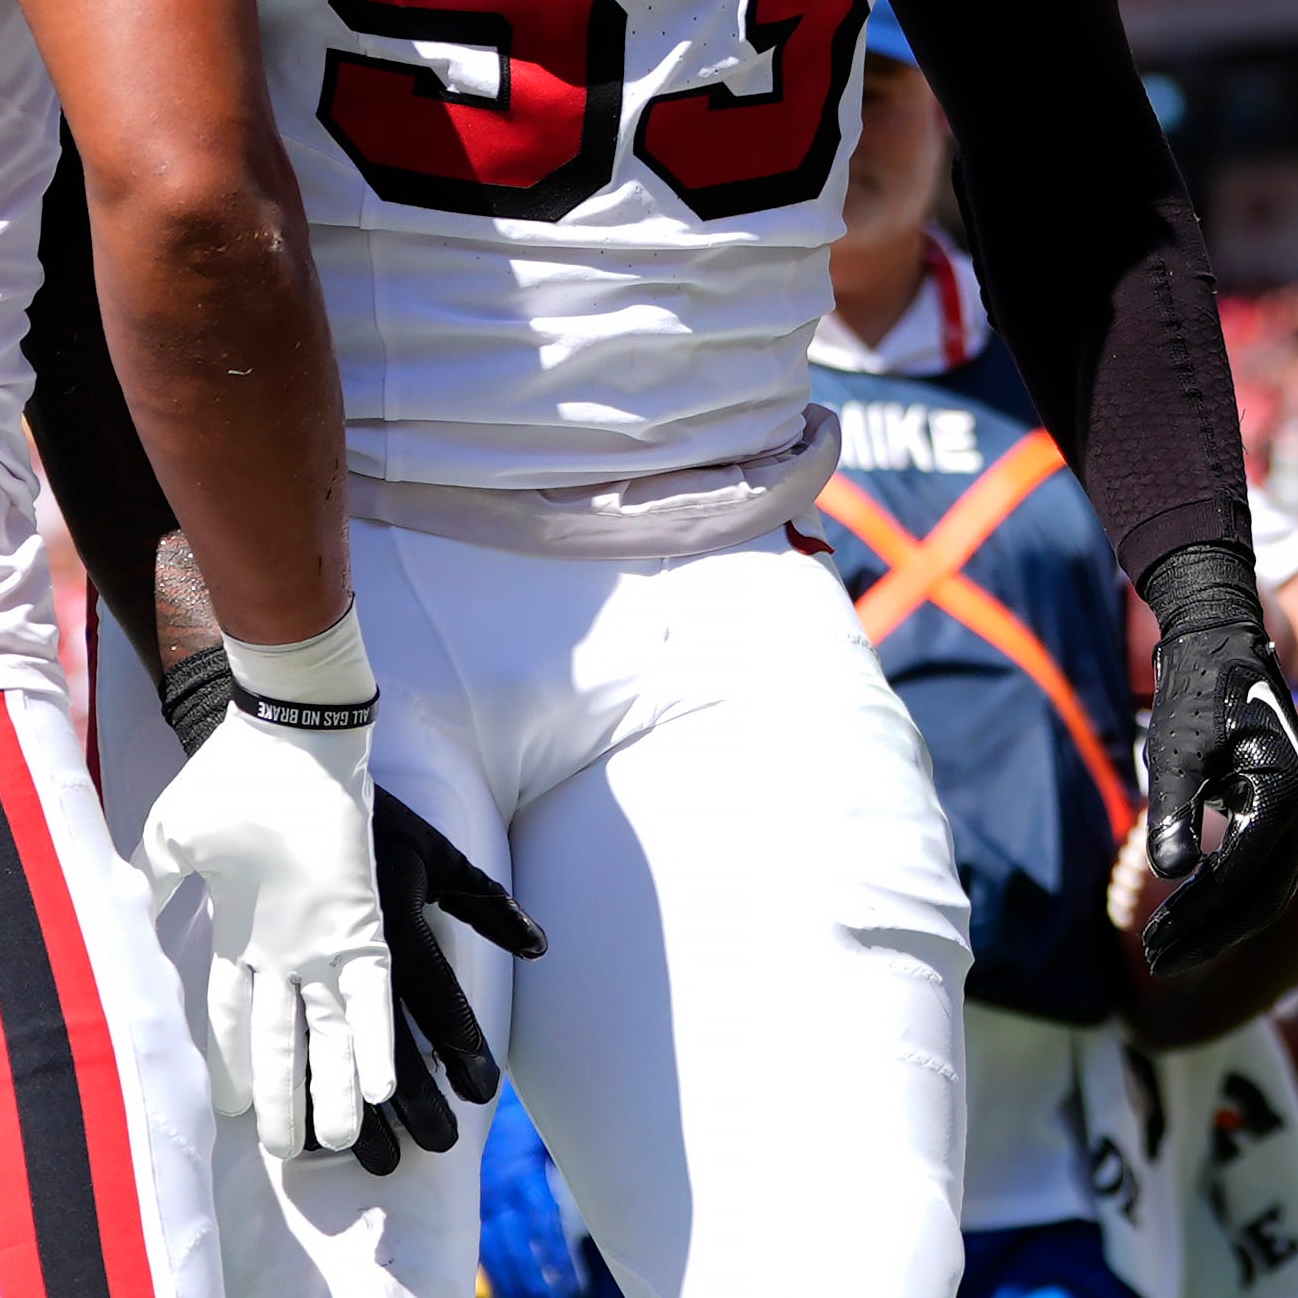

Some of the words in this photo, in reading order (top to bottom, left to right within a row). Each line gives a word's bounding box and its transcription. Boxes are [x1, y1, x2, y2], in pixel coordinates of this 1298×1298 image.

[257, 701, 300, 724] BRAKE
[302, 710, 321, 726] NO
[323, 711, 350, 727] GAS
[353, 707, 370, 724] ALL
